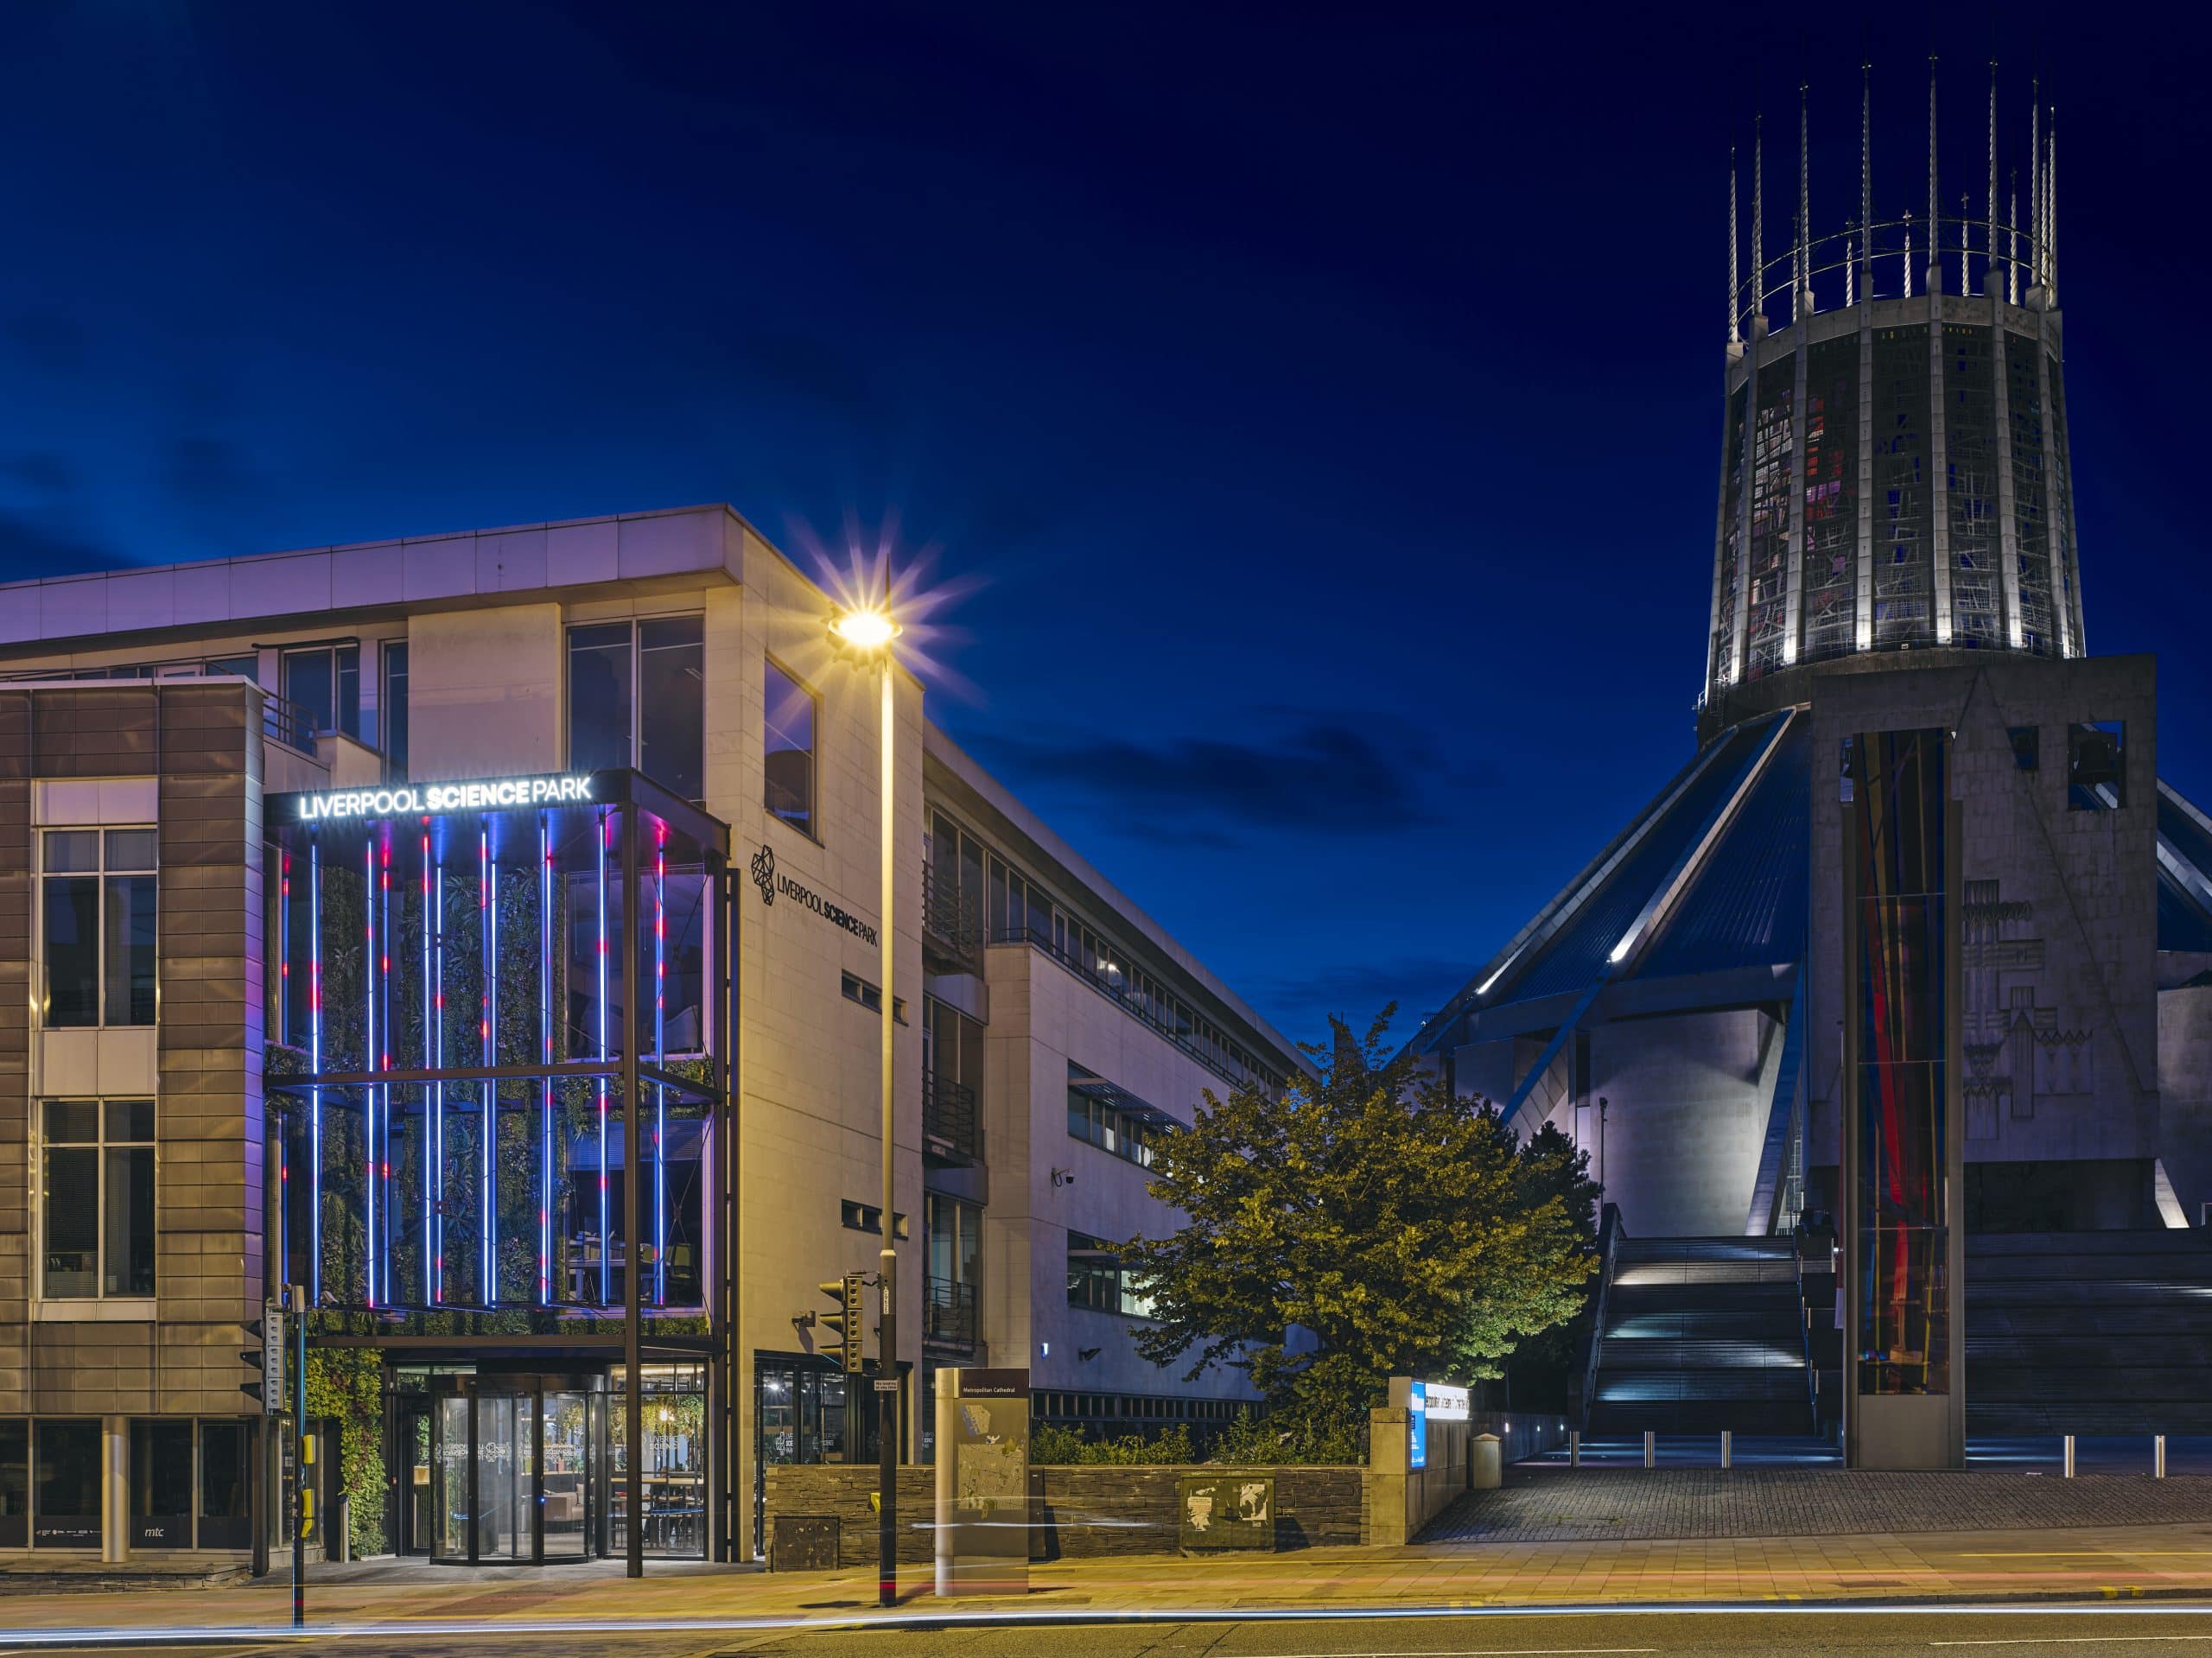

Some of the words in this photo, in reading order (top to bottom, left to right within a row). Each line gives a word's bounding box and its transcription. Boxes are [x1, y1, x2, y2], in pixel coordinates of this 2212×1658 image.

[300, 789, 423, 819] LIVERPOOL
[426, 781, 530, 810] SCIENCE
[531, 777, 593, 802] PARK
[777, 872, 823, 917] LIVERPOOL
[823, 901, 858, 936] SCIENCE
[858, 921, 878, 948] PARK
[144, 1527, 165, 1537] mtc
